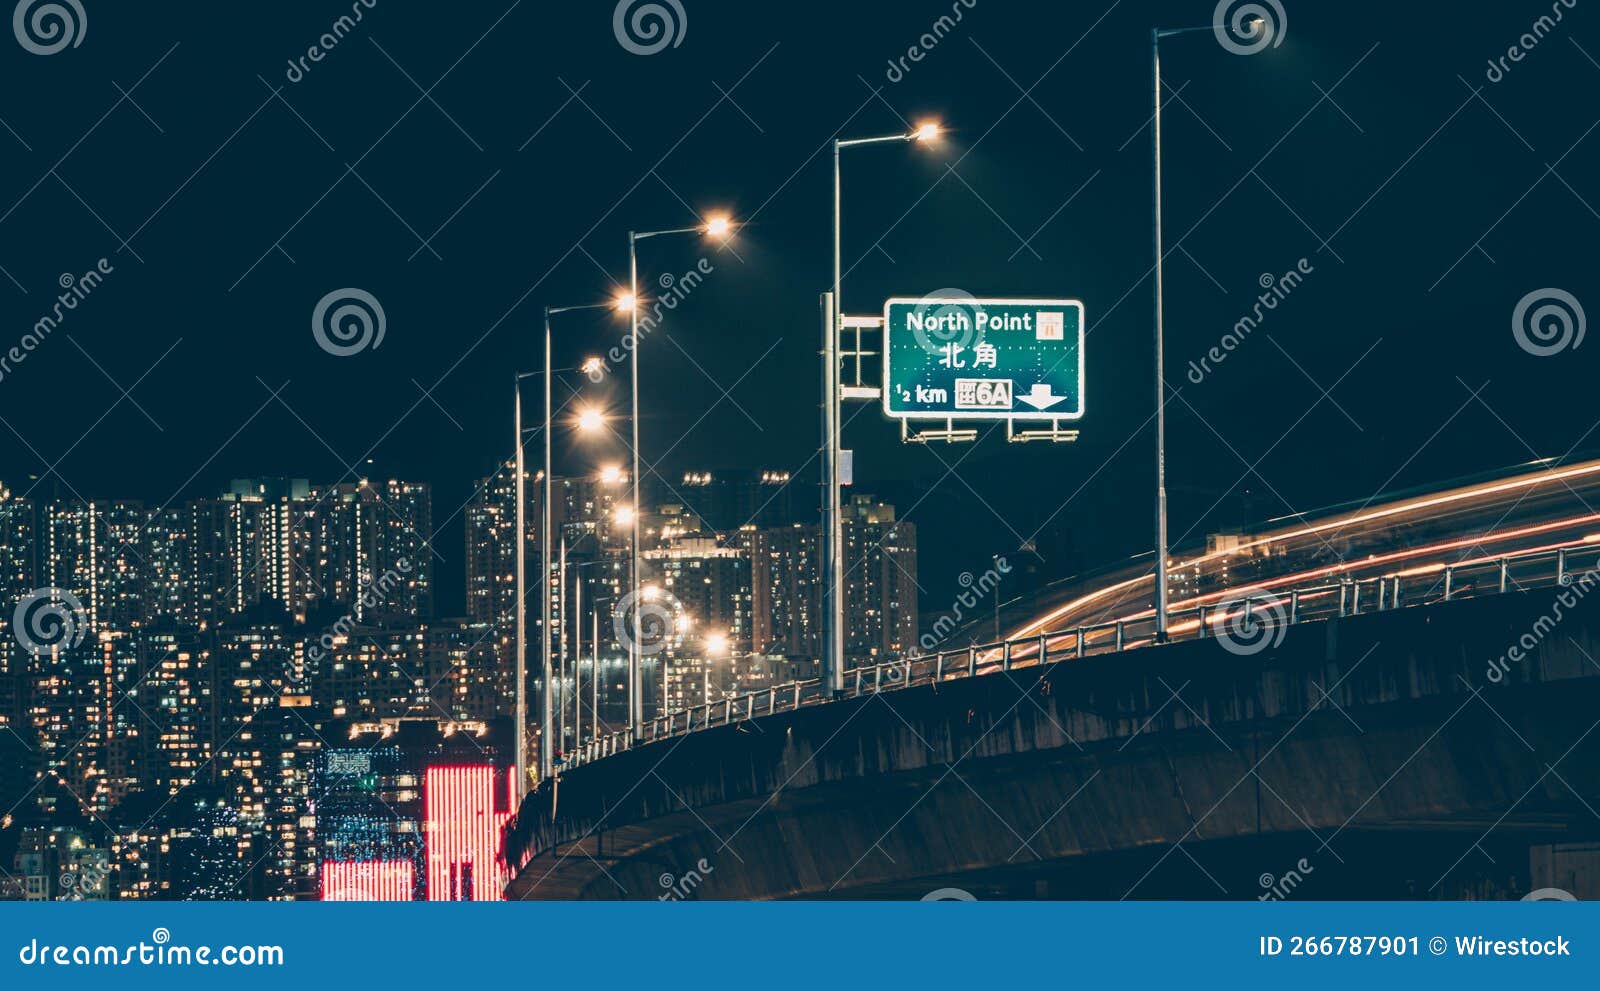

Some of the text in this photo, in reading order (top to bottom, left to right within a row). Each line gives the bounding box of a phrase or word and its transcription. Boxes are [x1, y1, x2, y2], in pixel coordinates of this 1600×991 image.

[906, 312, 1032, 331] North Point
[938, 341, 997, 368] 北角
[915, 384, 947, 403] km
